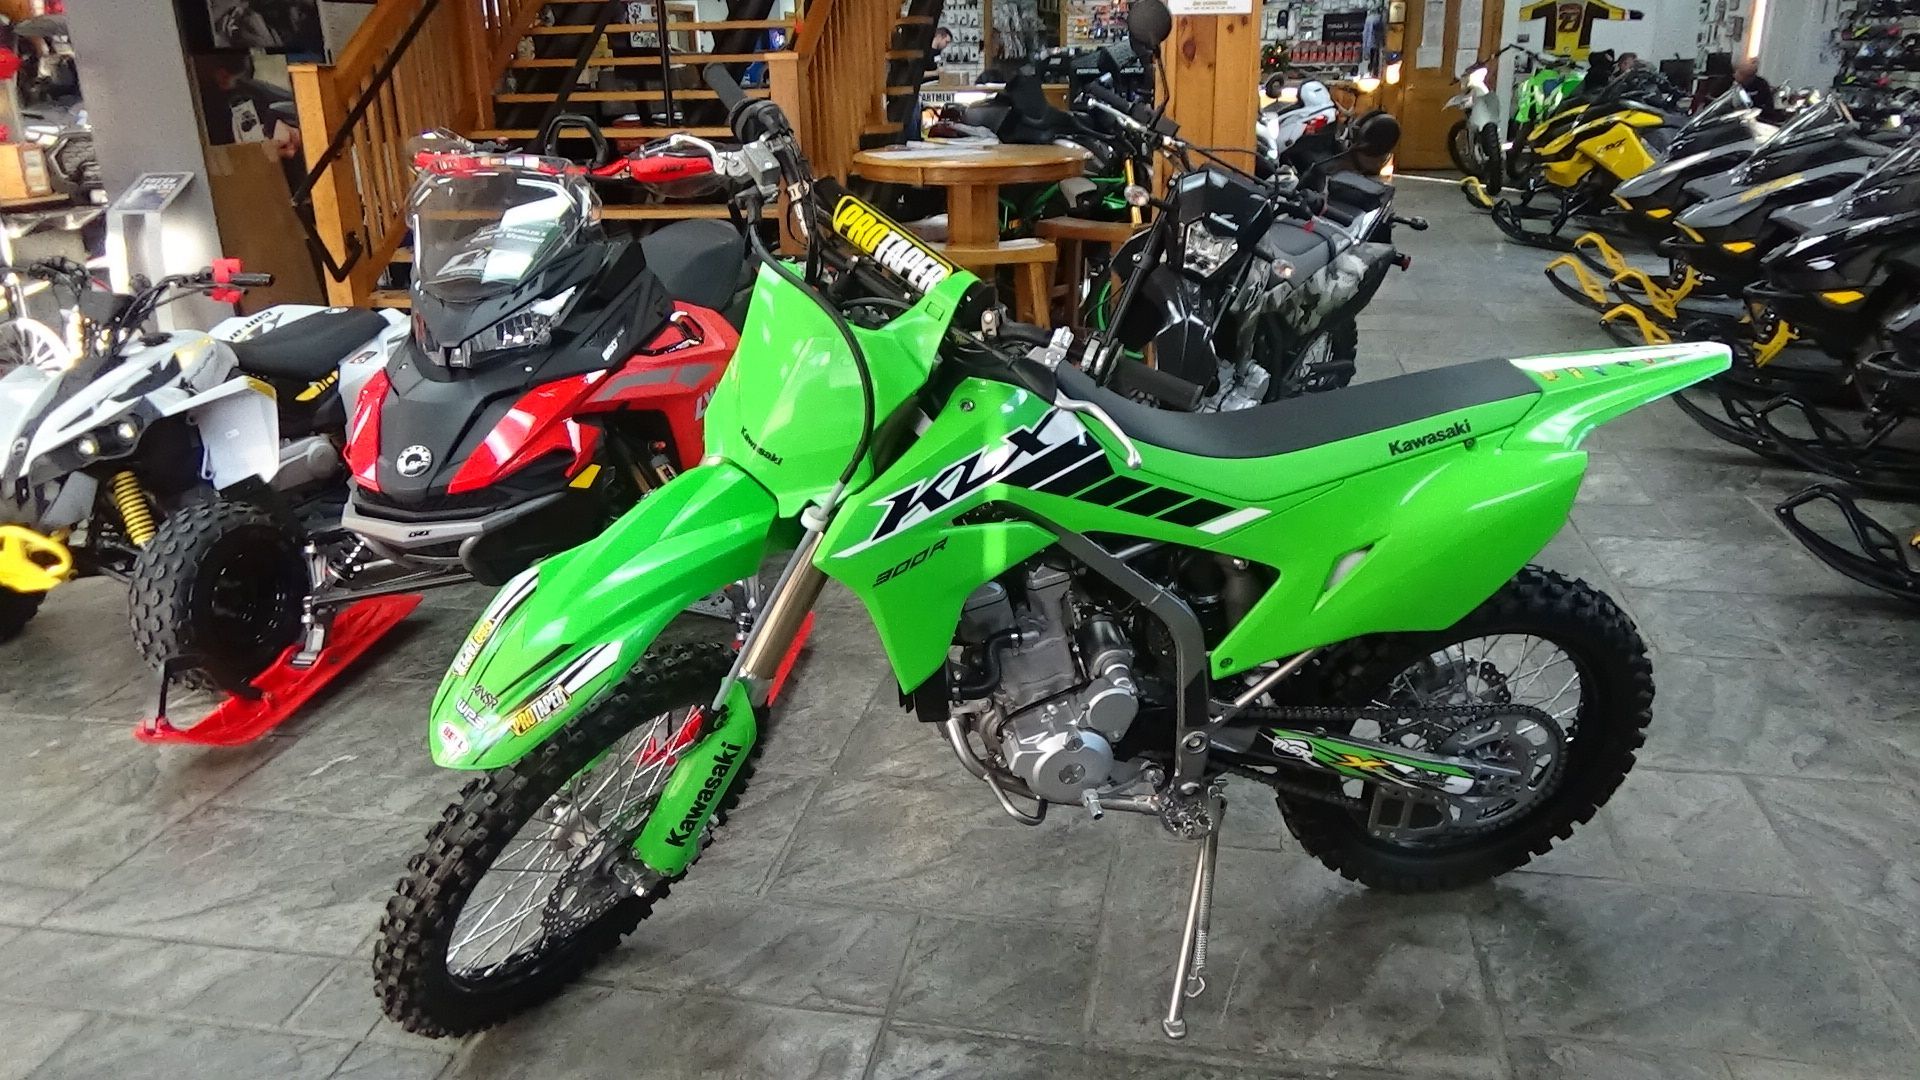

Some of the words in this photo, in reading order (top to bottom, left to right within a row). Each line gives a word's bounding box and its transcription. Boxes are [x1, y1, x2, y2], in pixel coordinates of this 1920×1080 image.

[1388, 419, 1471, 456] Kawasaki
[872, 407, 1060, 542] KLX
[872, 536, 949, 588] 300R
[443, 726, 463, 749] BEL
[665, 741, 743, 847] Kawasaki
